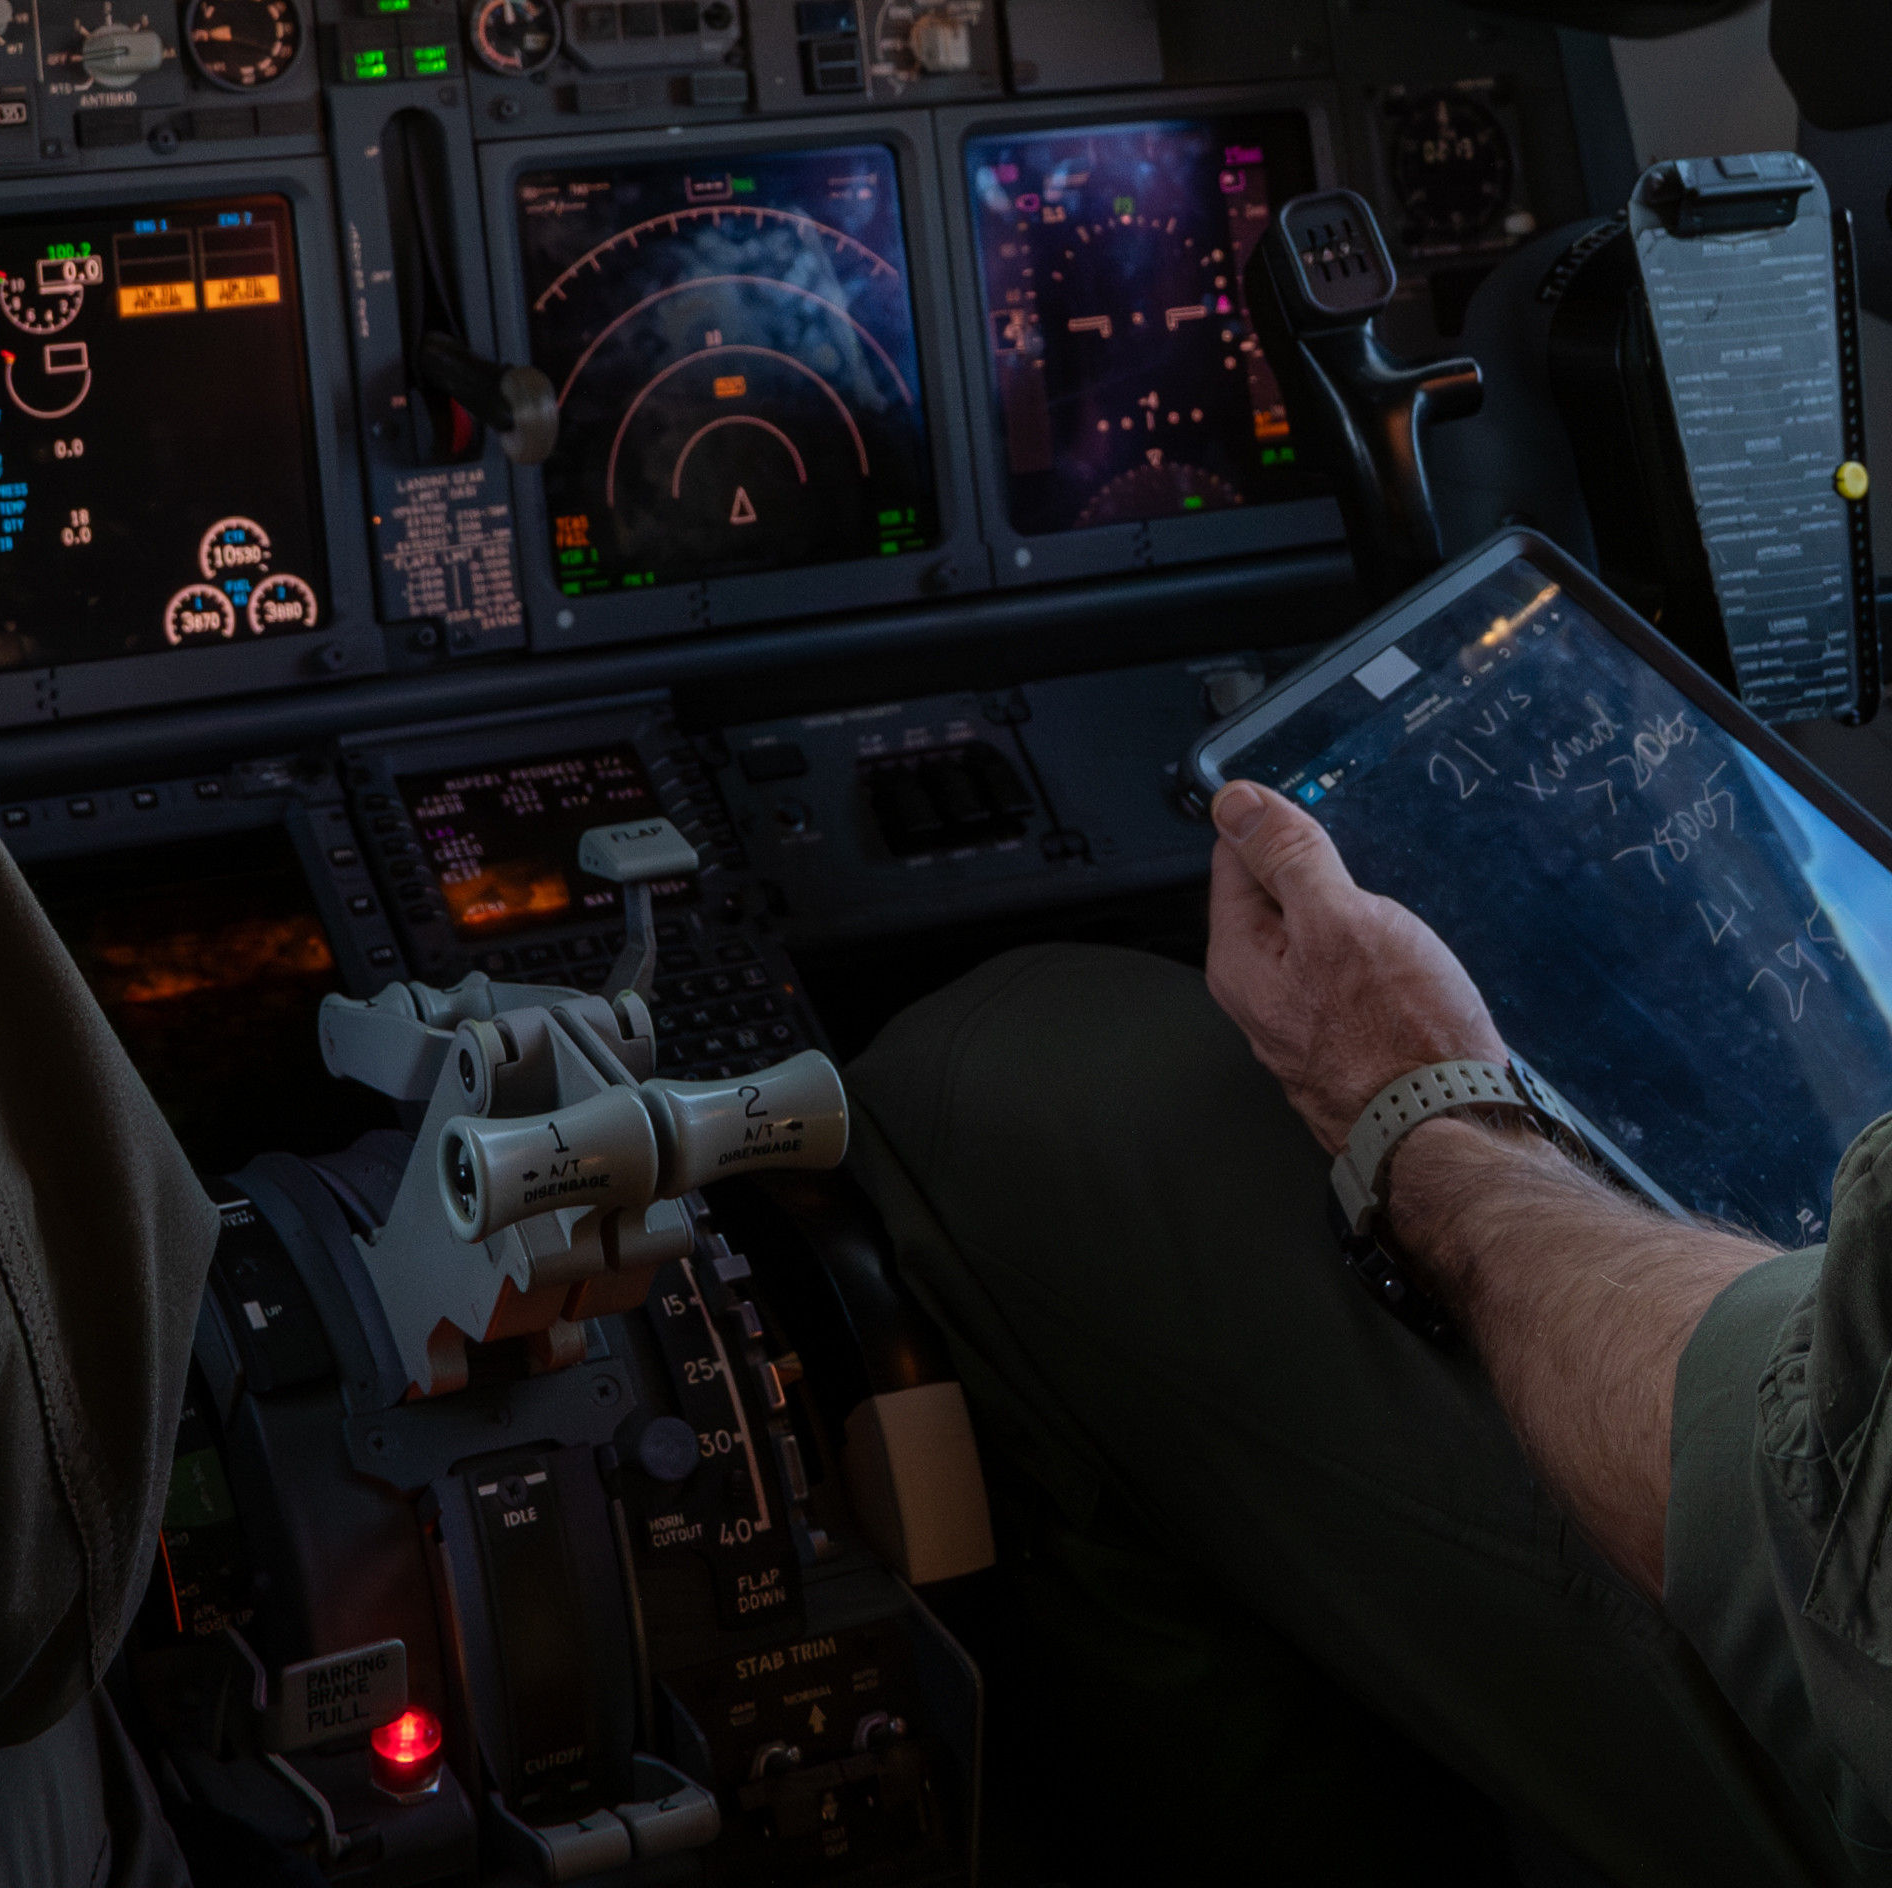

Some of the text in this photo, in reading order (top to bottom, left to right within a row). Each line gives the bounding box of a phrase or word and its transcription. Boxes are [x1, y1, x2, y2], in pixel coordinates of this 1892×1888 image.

[738, 1085, 768, 1118] 2
[549, 1121, 569, 1153] 1
[744, 1123, 774, 1142] A/T
[719, 1139, 802, 1165] DISENGAGE
[550, 1159, 581, 1177] A/T
[524, 1174, 610, 1203] DISENGAGE
[661, 1293, 686, 1318] 15
[684, 1359, 715, 1385] 25
[699, 1430, 732, 1458] 30
[503, 1506, 538, 1528] IDLE
[652, 1523, 703, 1548] CUTOUT
[719, 1518, 753, 1546] 40
[736, 1568, 780, 1595] FLAP
[737, 1587, 786, 1614] DOWN
[307, 1654, 388, 1688] PARKING
[734, 1636, 837, 1681] STAB TRIM
[307, 1677, 370, 1709] BRAKE
[308, 1705, 370, 1732] PULL
